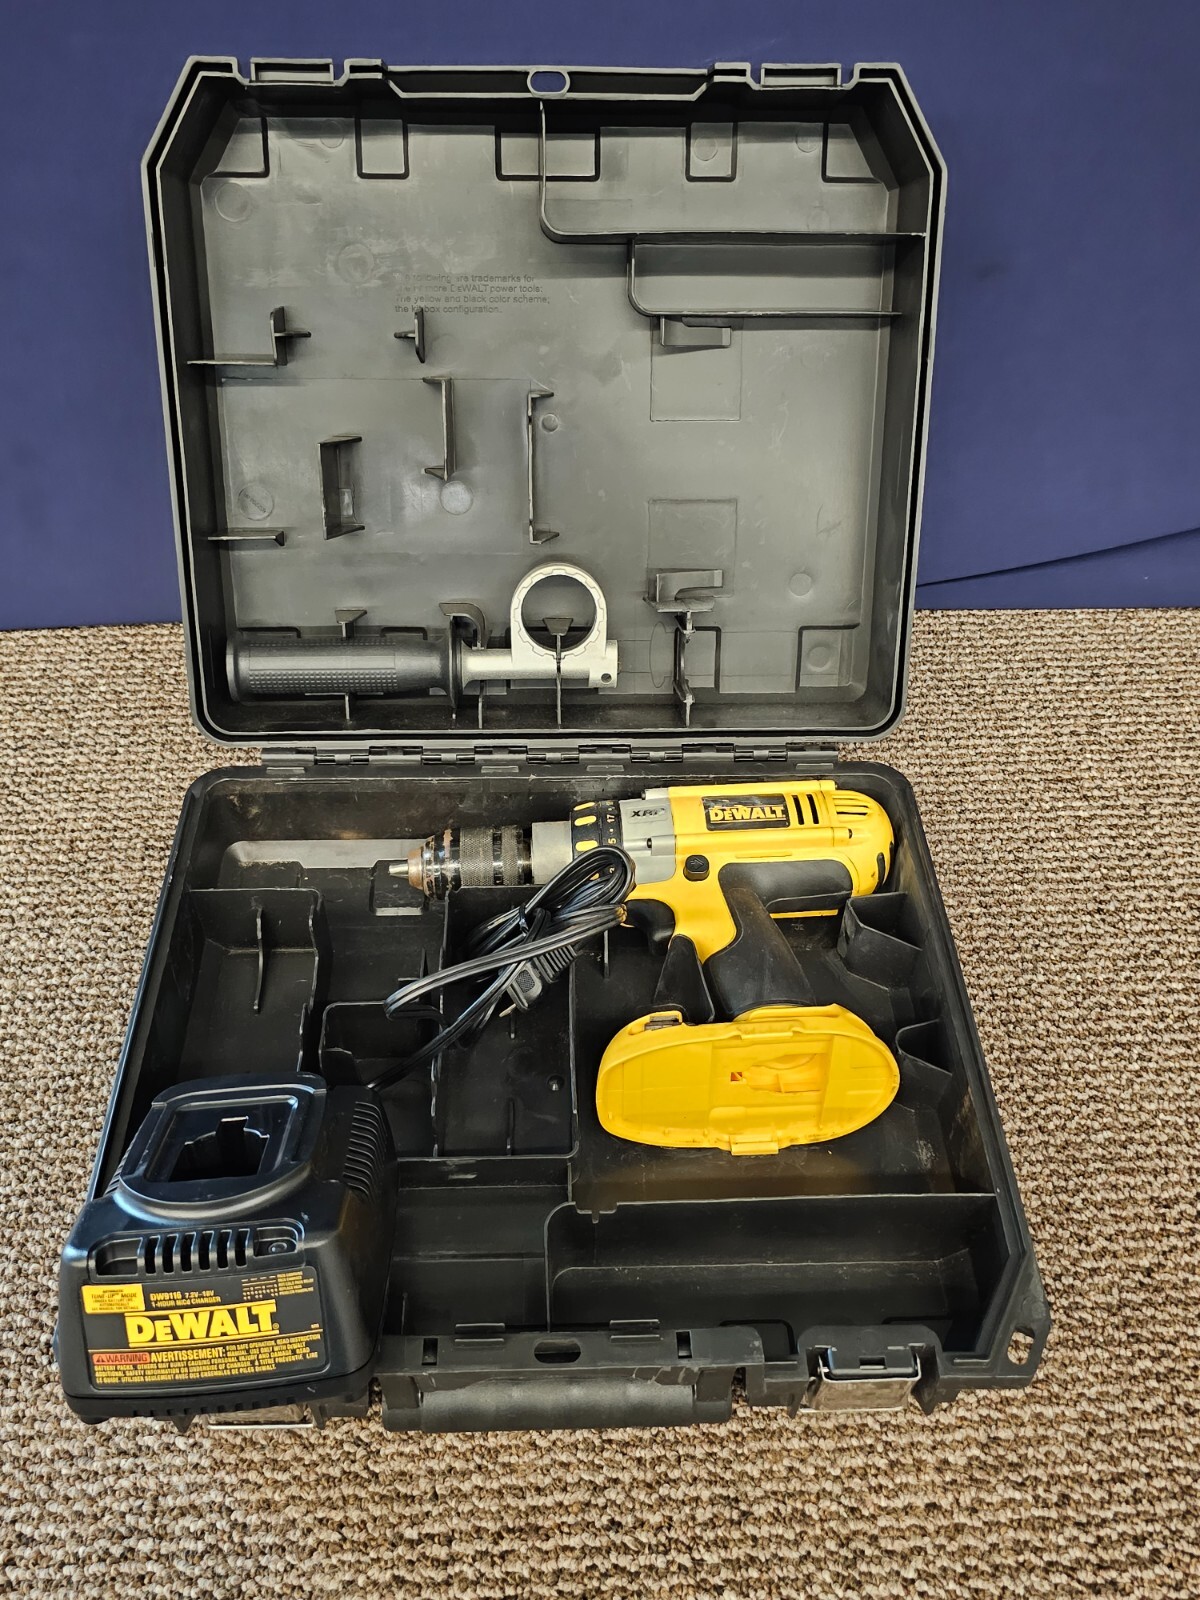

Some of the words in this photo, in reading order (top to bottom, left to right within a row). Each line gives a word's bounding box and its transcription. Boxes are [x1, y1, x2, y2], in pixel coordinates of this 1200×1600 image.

[471, 274, 521, 283] trademarks
[523, 274, 535, 282] for
[425, 285, 447, 293] more
[490, 286, 517, 294] power
[414, 295, 442, 305] yellow
[444, 295, 461, 303] and
[463, 294, 487, 303] black
[488, 294, 511, 303] color
[395, 305, 409, 313] the
[424, 305, 441, 313] box
[149, 1291, 182, 1302] DW9116
[191, 1295, 222, 1305] CHARGER
[105, 1353, 149, 1363] WARNING
[151, 1346, 226, 1364] AVERTISSEMENT:
